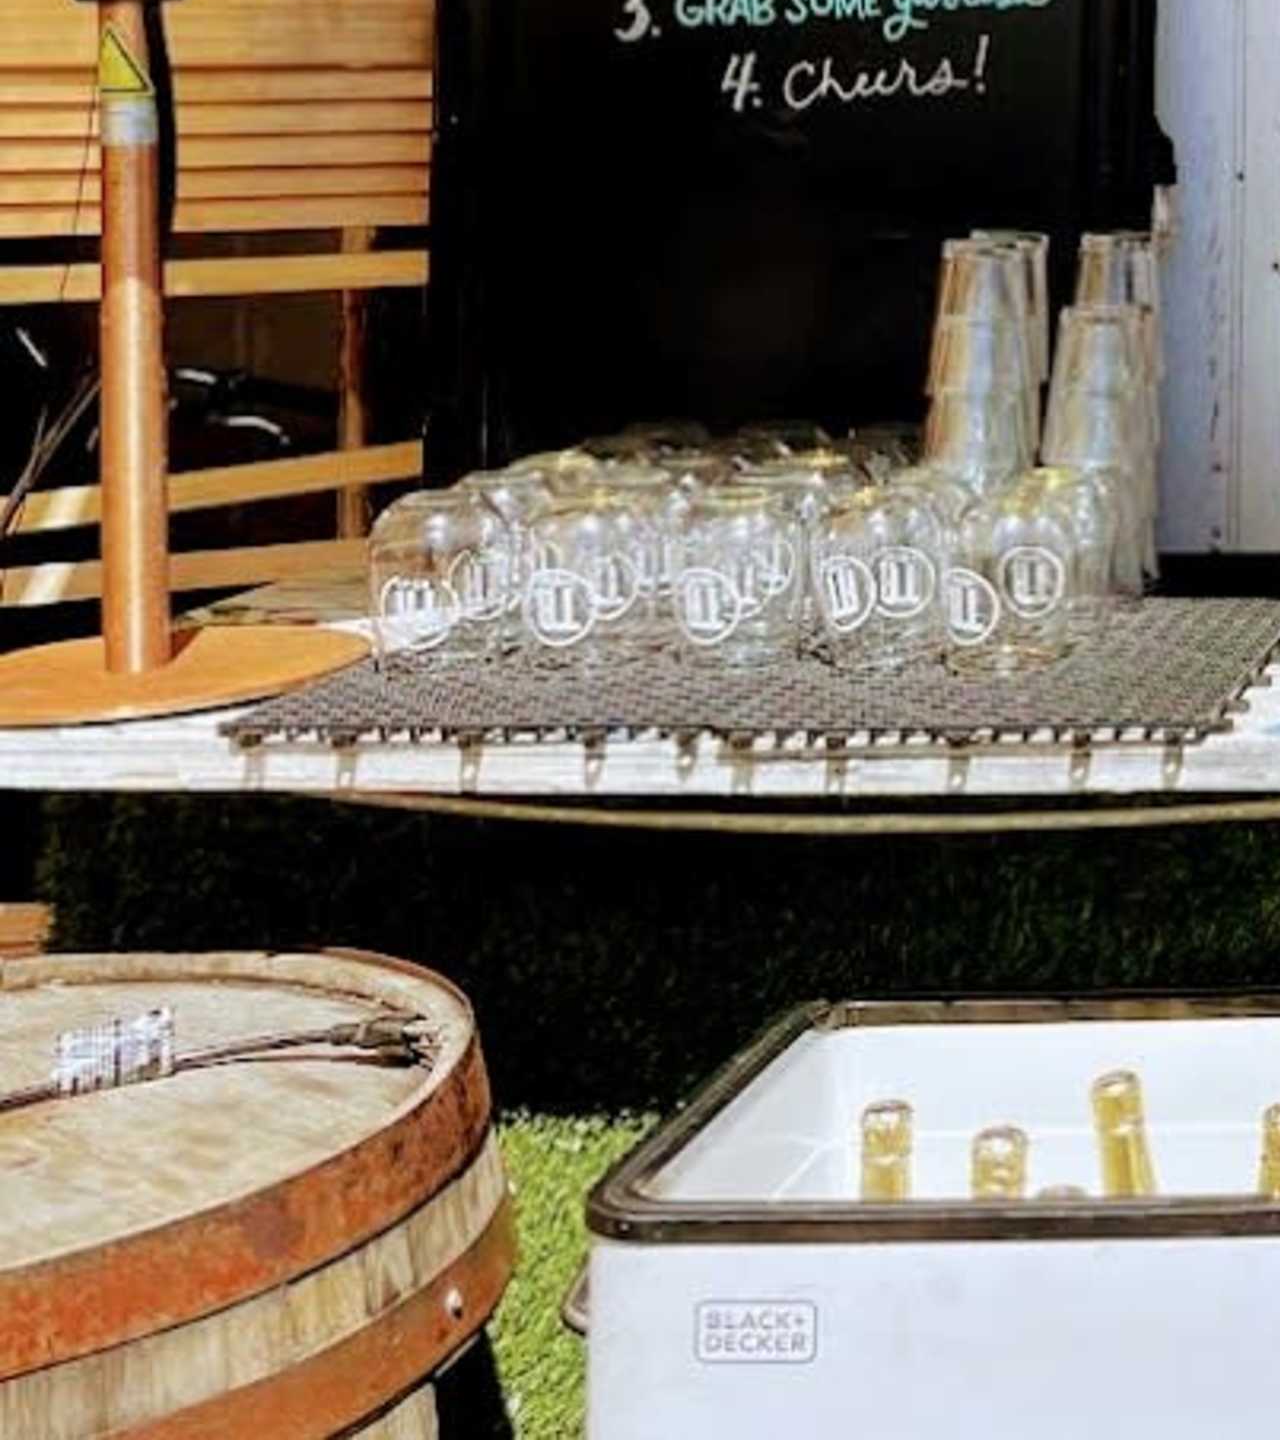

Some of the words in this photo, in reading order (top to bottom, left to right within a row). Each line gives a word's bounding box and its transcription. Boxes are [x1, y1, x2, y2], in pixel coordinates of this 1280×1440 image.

[721, 52, 763, 112] 4.
[782, 34, 990, 110] Cheers!
[705, 1331, 807, 1353] DECKER
